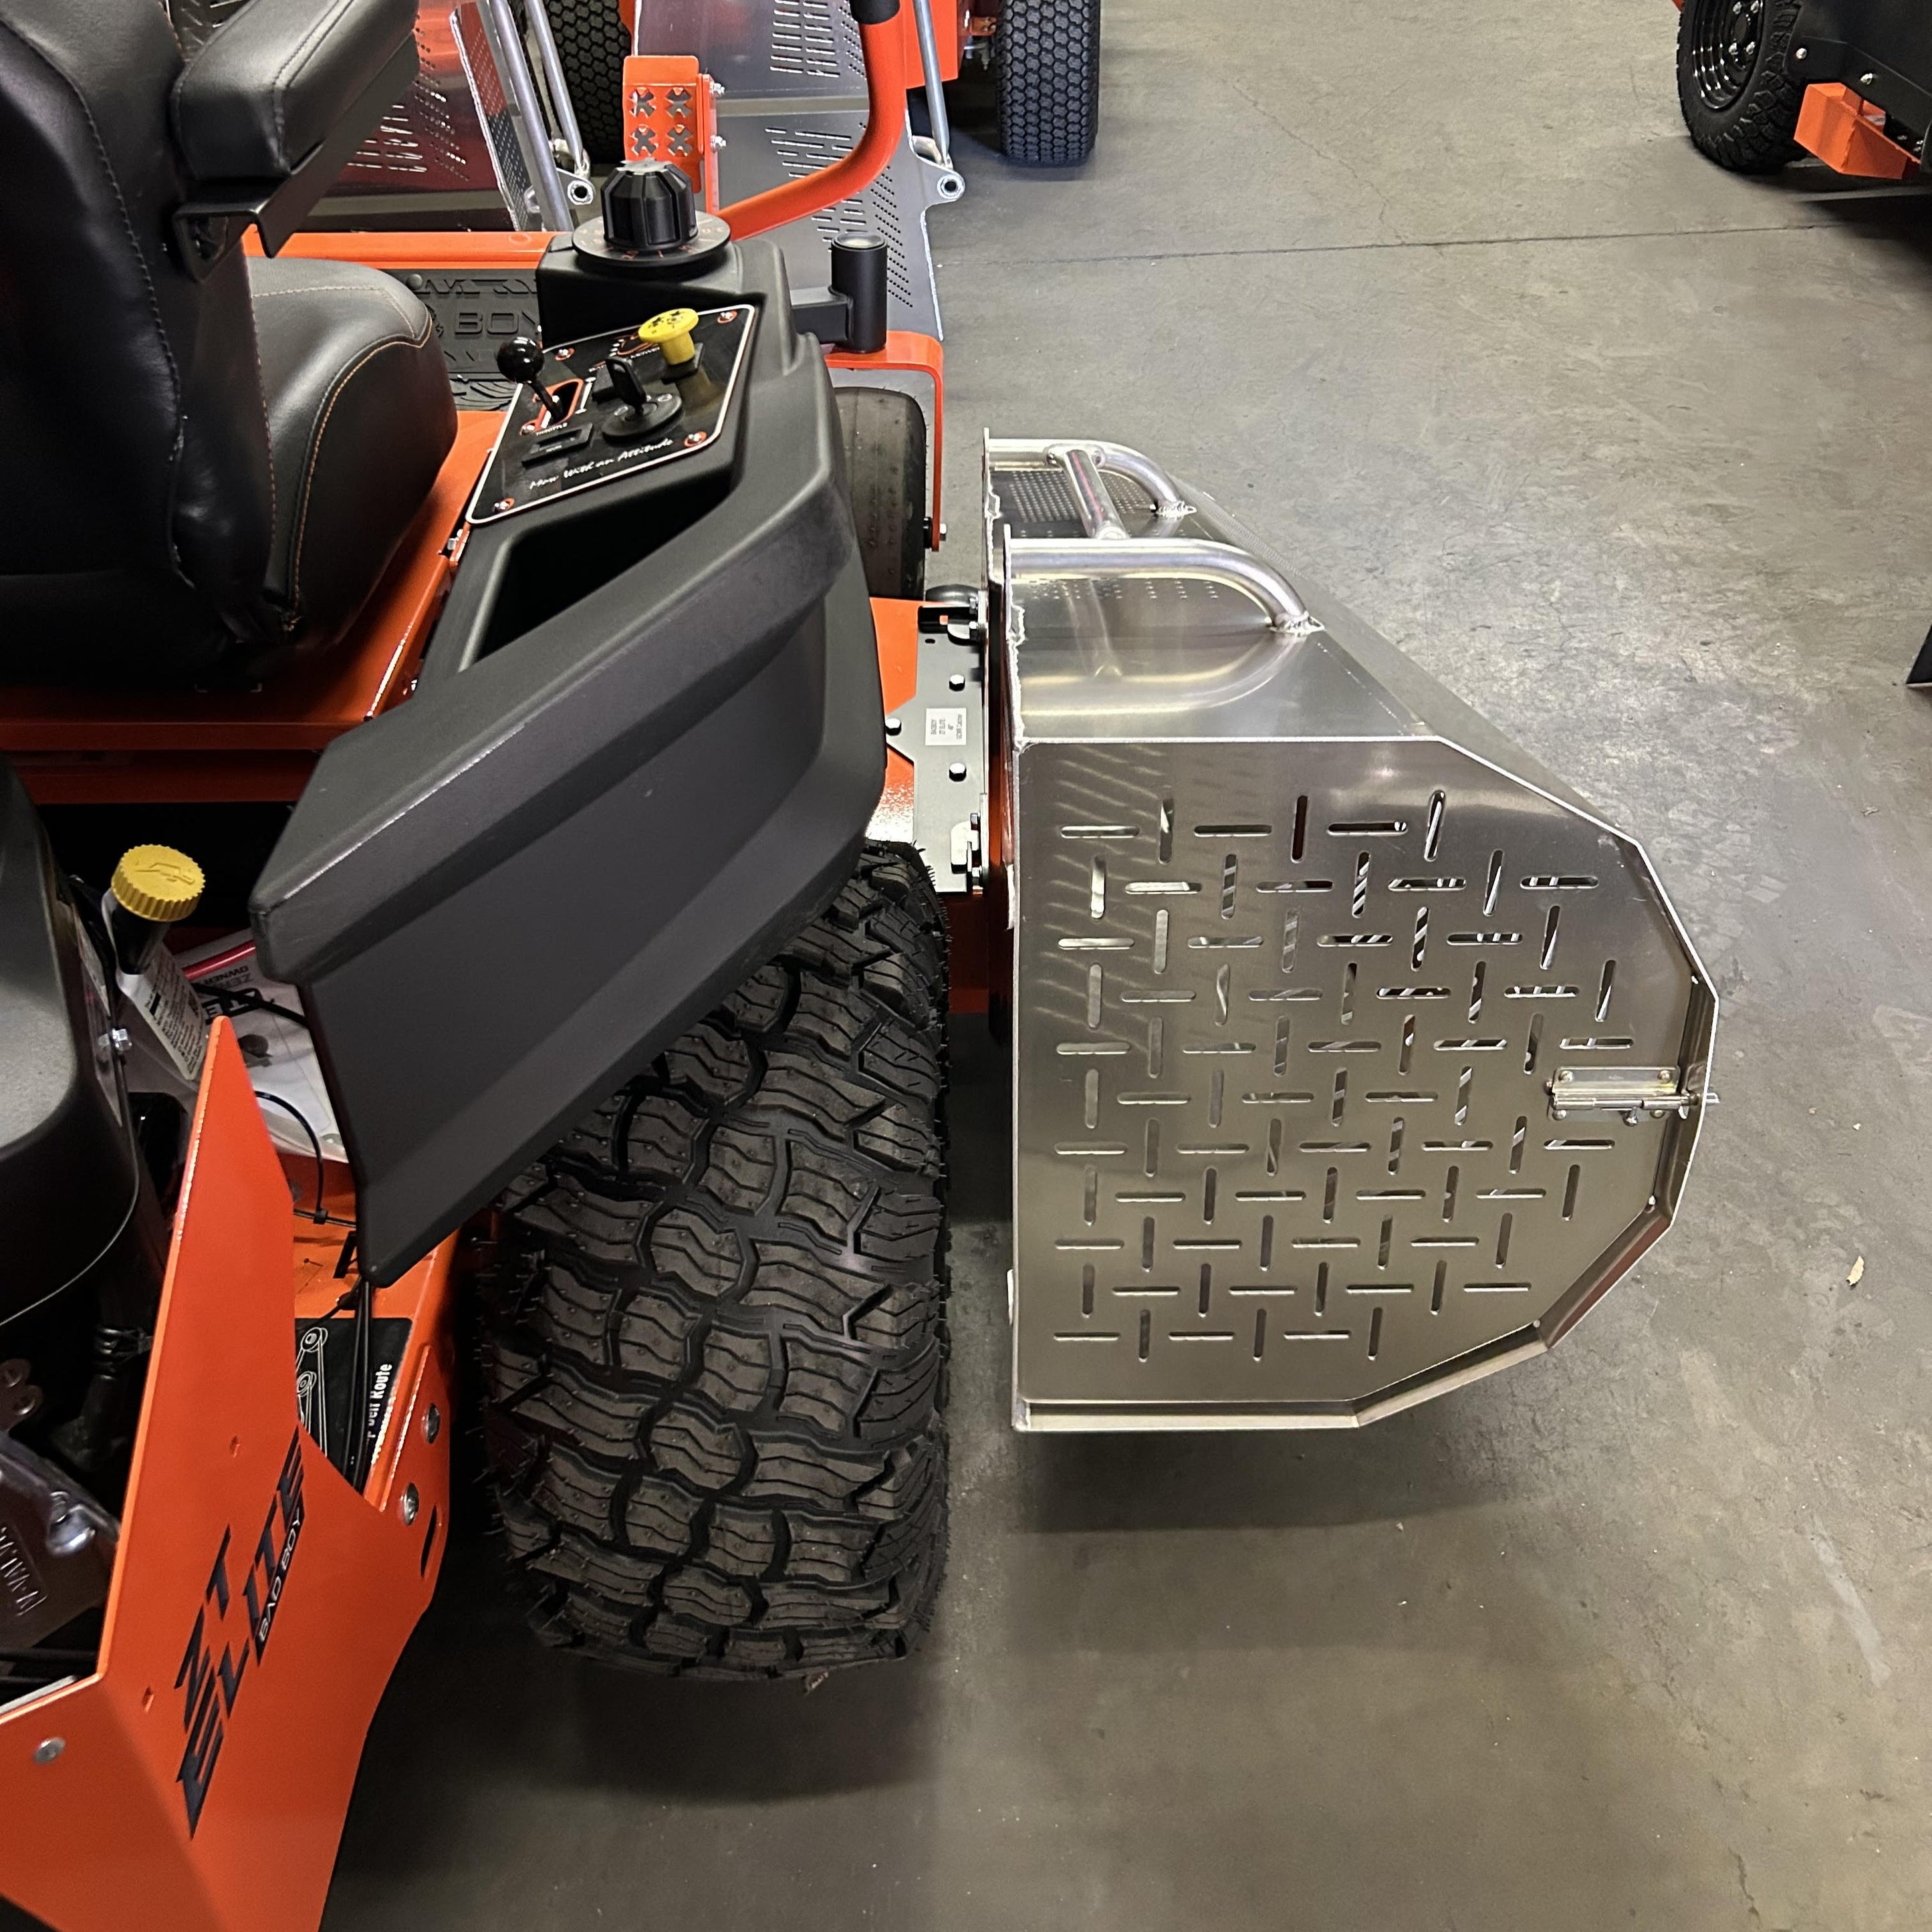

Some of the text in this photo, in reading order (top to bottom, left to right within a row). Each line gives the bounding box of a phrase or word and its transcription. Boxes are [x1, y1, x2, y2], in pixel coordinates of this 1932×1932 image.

[529, 475, 560, 489] Mow
[617, 438, 674, 461] Attitude
[370, 1364, 392, 1399] Route
[174, 1524, 231, 1734] ZT
[176, 1425, 304, 1840] ELITE
[259, 1506, 300, 1642] BAD BOY
